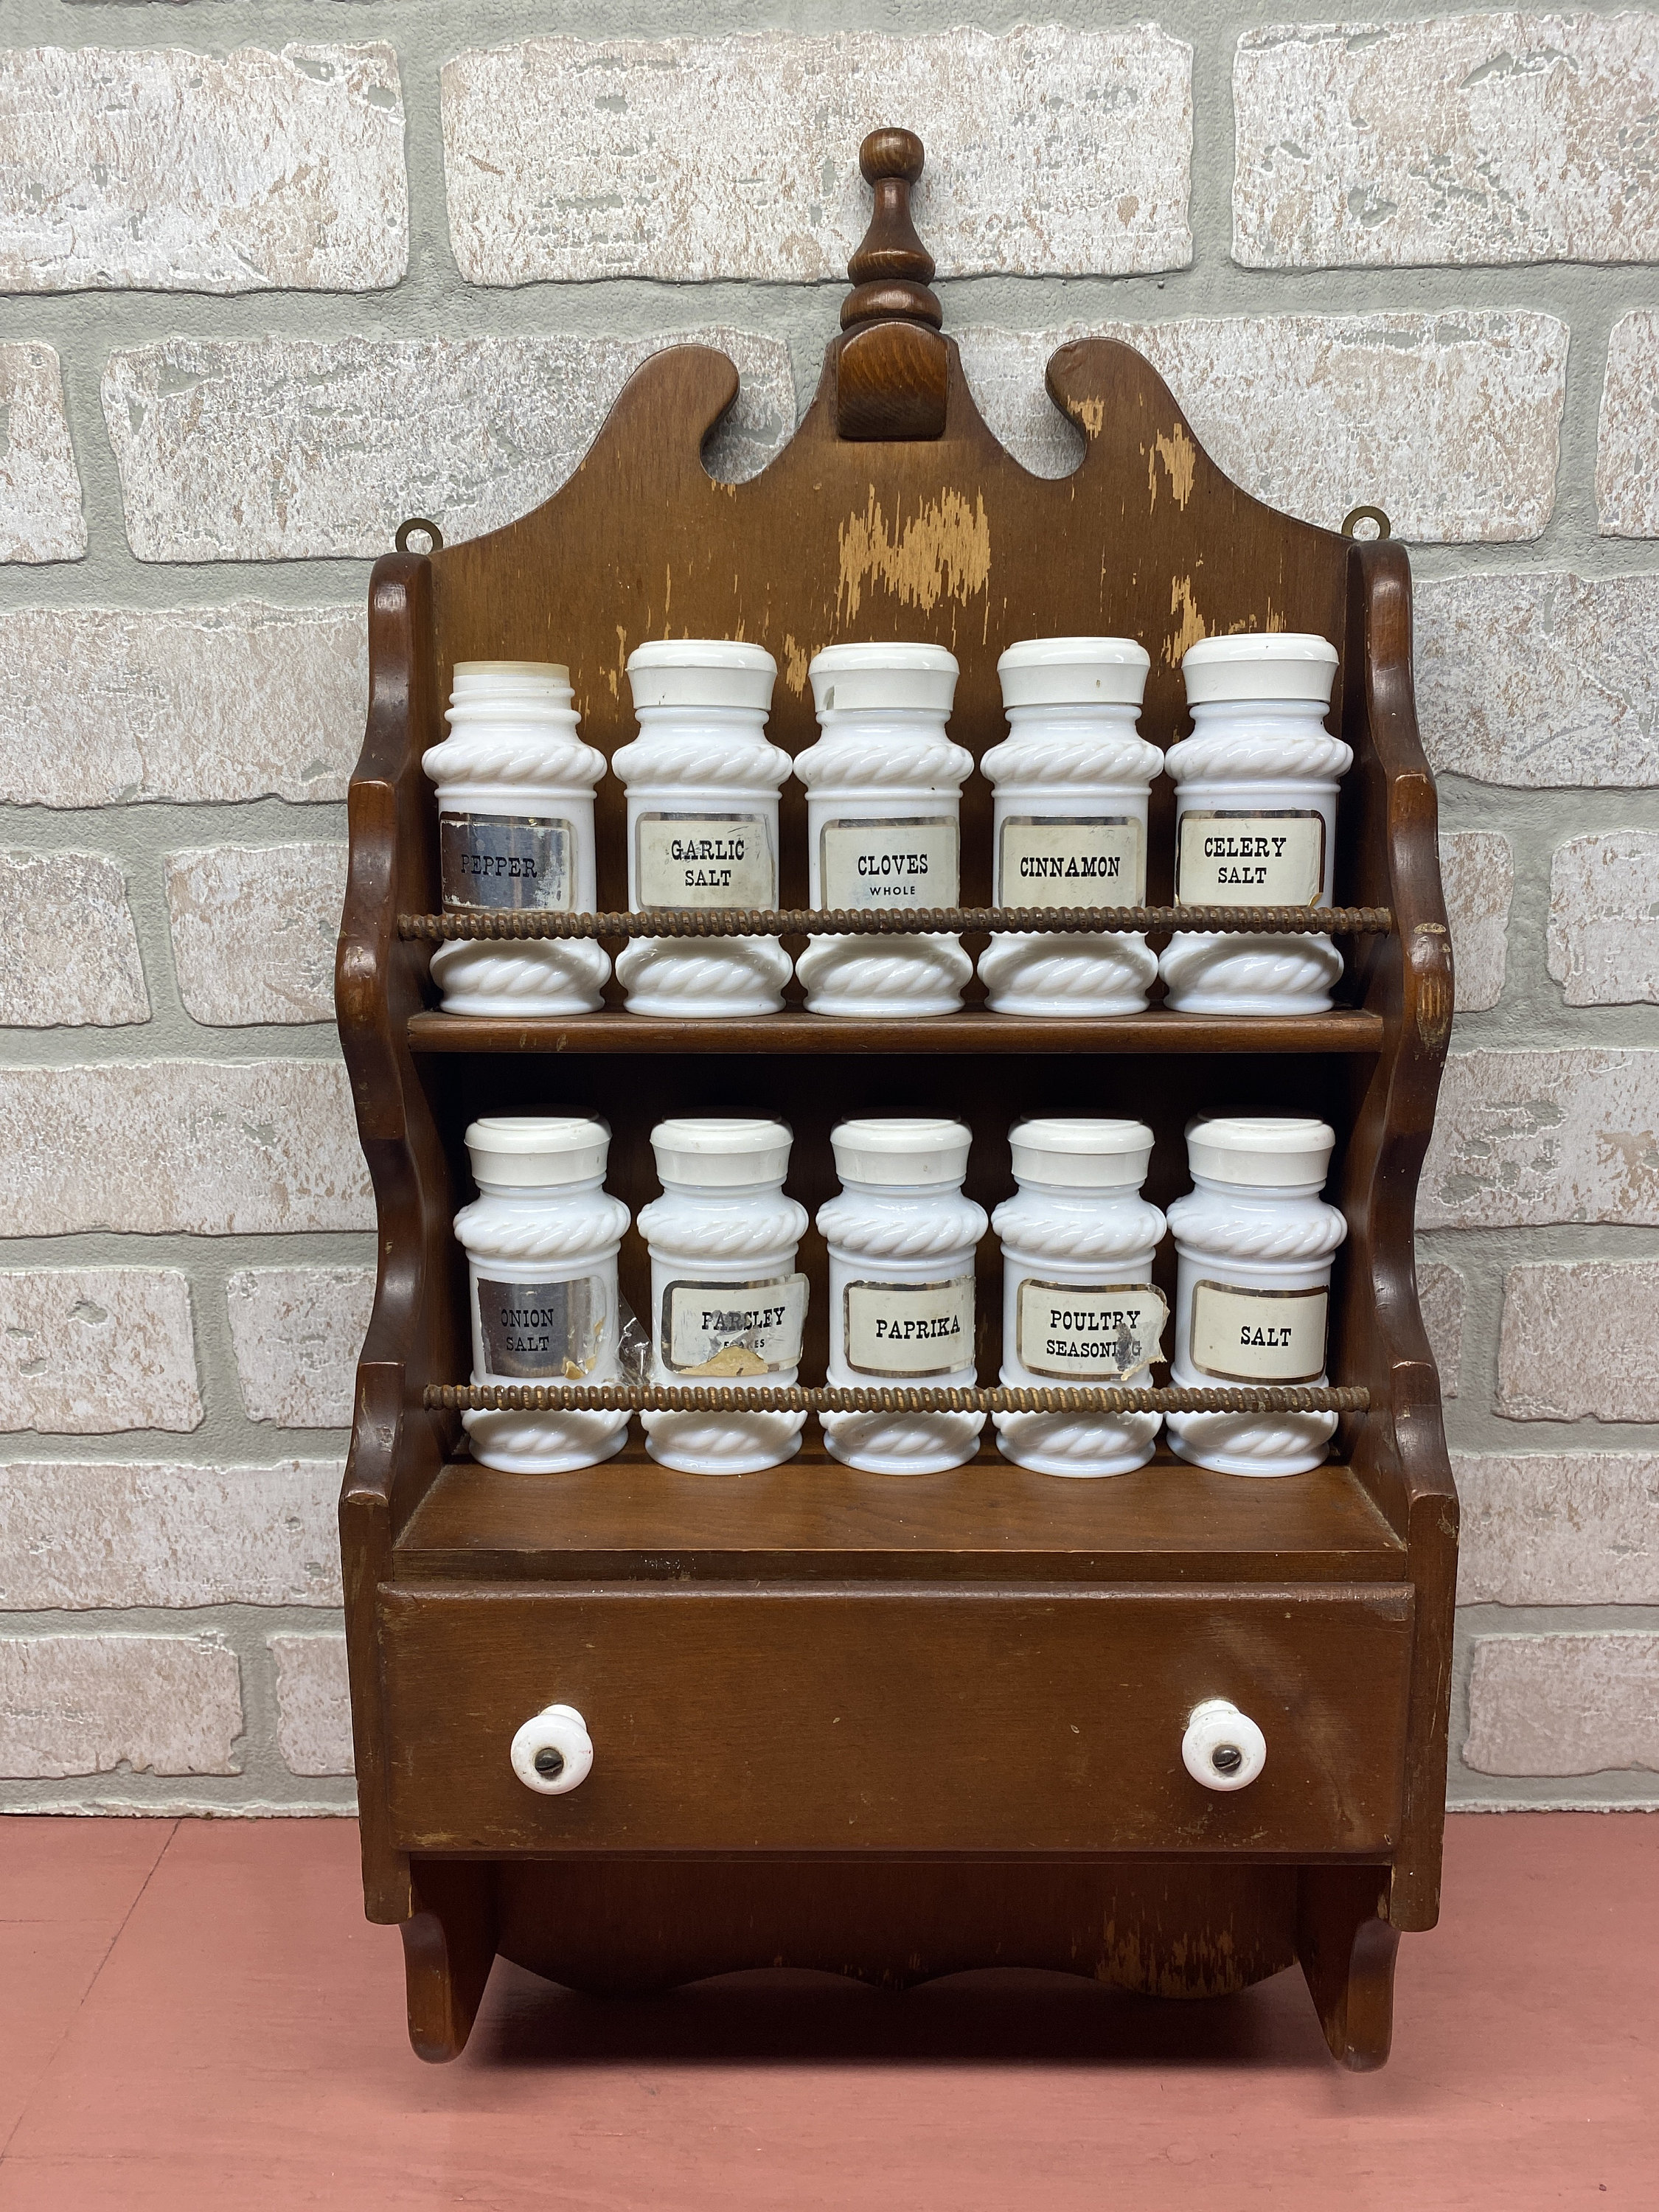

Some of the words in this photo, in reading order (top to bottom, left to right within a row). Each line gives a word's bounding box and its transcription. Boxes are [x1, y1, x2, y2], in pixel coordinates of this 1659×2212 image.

[671, 839, 745, 861] GARLIC
[1204, 837, 1287, 858] CELERY
[460, 854, 538, 879] PEPPER
[857, 853, 929, 876] CLOVES
[1020, 856, 1121, 878] CINNAMON
[1218, 866, 1267, 884] SALT
[684, 869, 732, 887] SALT
[869, 886, 916, 897] WHOLE
[501, 1308, 554, 1328] ONION
[875, 1315, 961, 1340] PAPRIKA
[1050, 1309, 1141, 1332] POULTRY
[506, 1336, 549, 1352] SALT
[1240, 1326, 1292, 1347] SALT
[1046, 1339, 1143, 1358] SEASONIG
